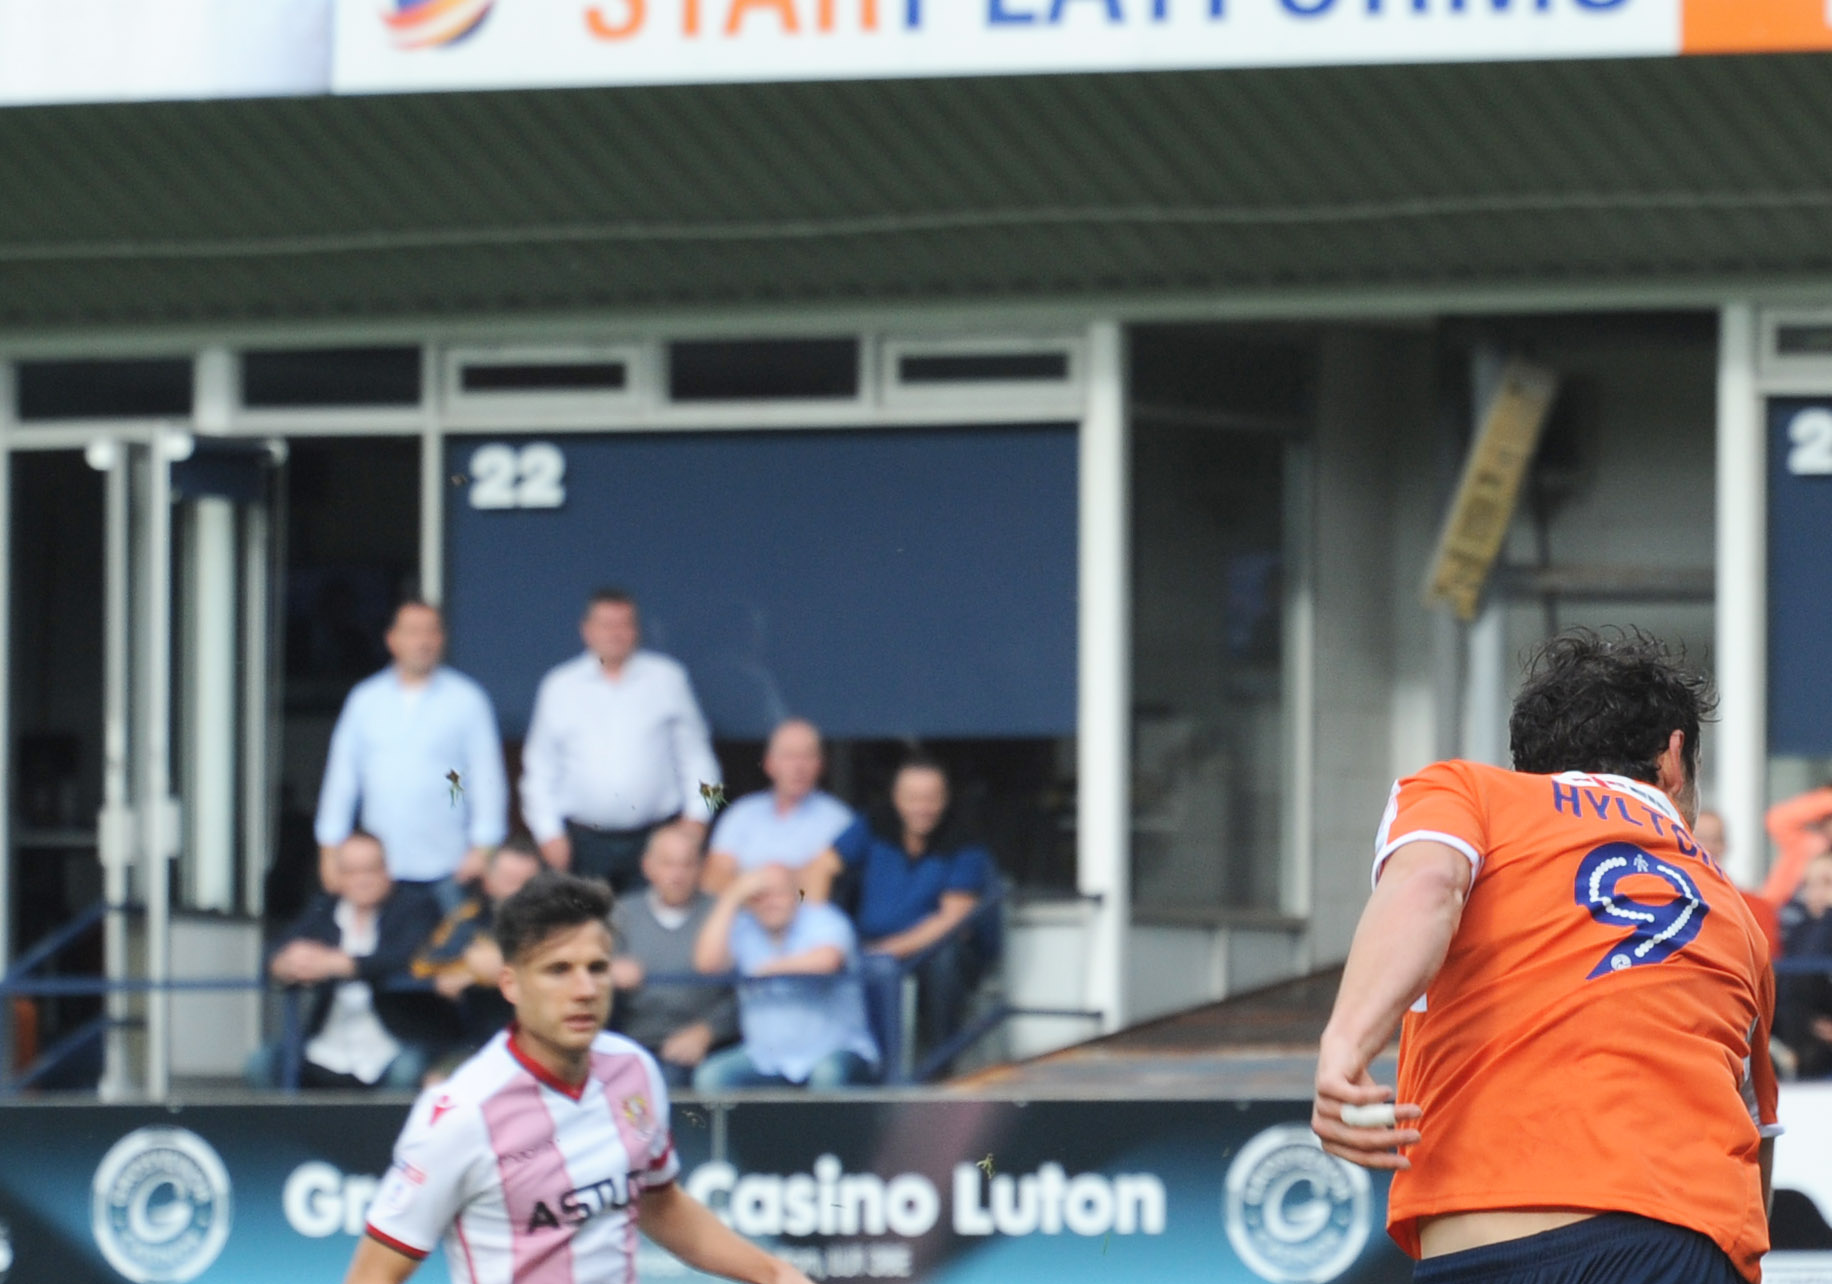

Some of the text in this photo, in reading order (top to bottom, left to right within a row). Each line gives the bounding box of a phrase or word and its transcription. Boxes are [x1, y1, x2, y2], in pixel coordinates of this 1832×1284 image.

[468, 441, 566, 510] 22
[1574, 841, 1711, 980] 9
[684, 1153, 940, 1238] Casino
[953, 1161, 1168, 1237] Luton
